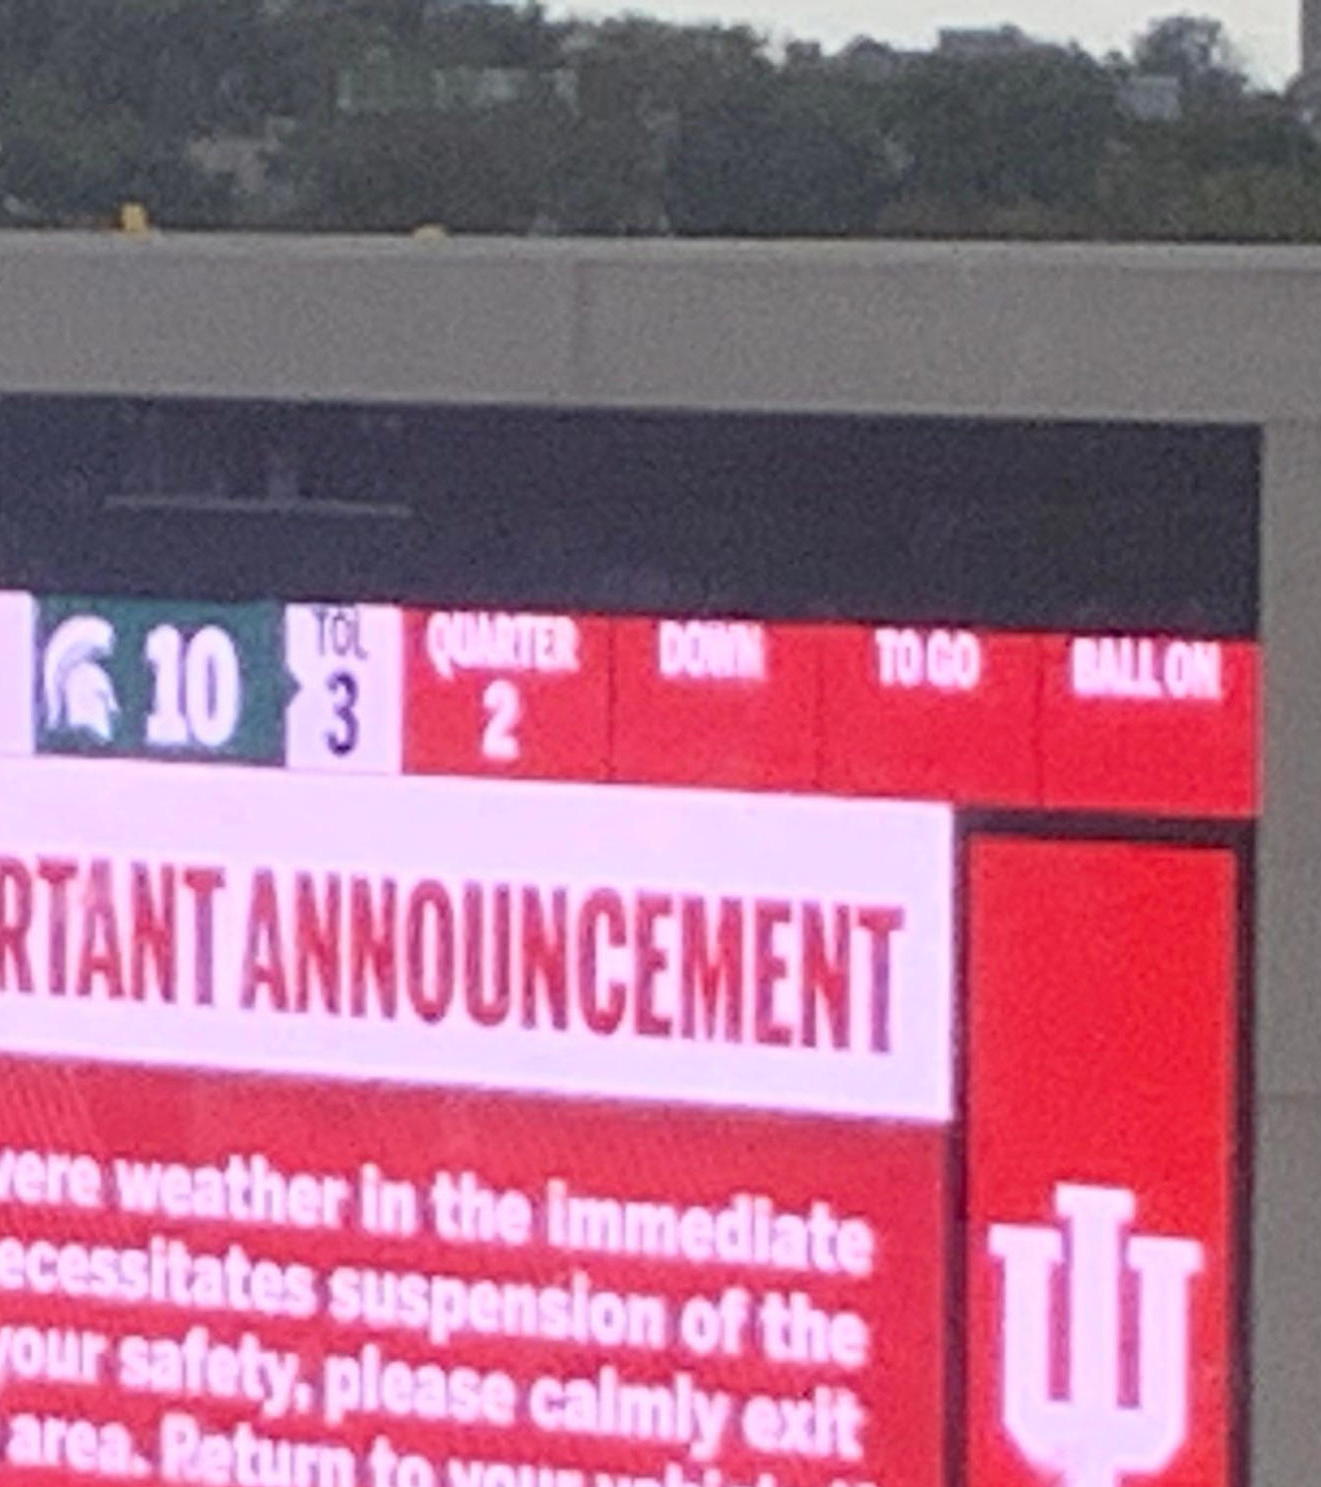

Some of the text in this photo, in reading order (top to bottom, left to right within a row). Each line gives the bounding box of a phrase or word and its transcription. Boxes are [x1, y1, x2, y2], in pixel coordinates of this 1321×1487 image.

[315, 607, 368, 659] TOL
[426, 613, 578, 682] QUARTER
[659, 621, 766, 682] DOWN
[876, 629, 979, 690] TO GO
[1072, 639, 1219, 700] BALL ON
[145, 624, 241, 747] 10
[327, 674, 360, 757] 3
[483, 683, 520, 759] 2
[240, 868, 904, 1056] ANNOUNCEMENT
[115, 1153, 347, 1228] weather
[361, 1163, 414, 1234] in
[432, 1171, 530, 1245] the
[547, 1178, 874, 1276] immediate
[329, 1270, 665, 1348] suspension
[681, 1287, 747, 1354] of
[760, 1292, 868, 1369] the
[117, 1326, 311, 1418] safety,
[324, 1343, 516, 1425] please
[529, 1366, 730, 1461] calmly
[743, 1386, 862, 1460] exit
[7, 1414, 150, 1477] area.
